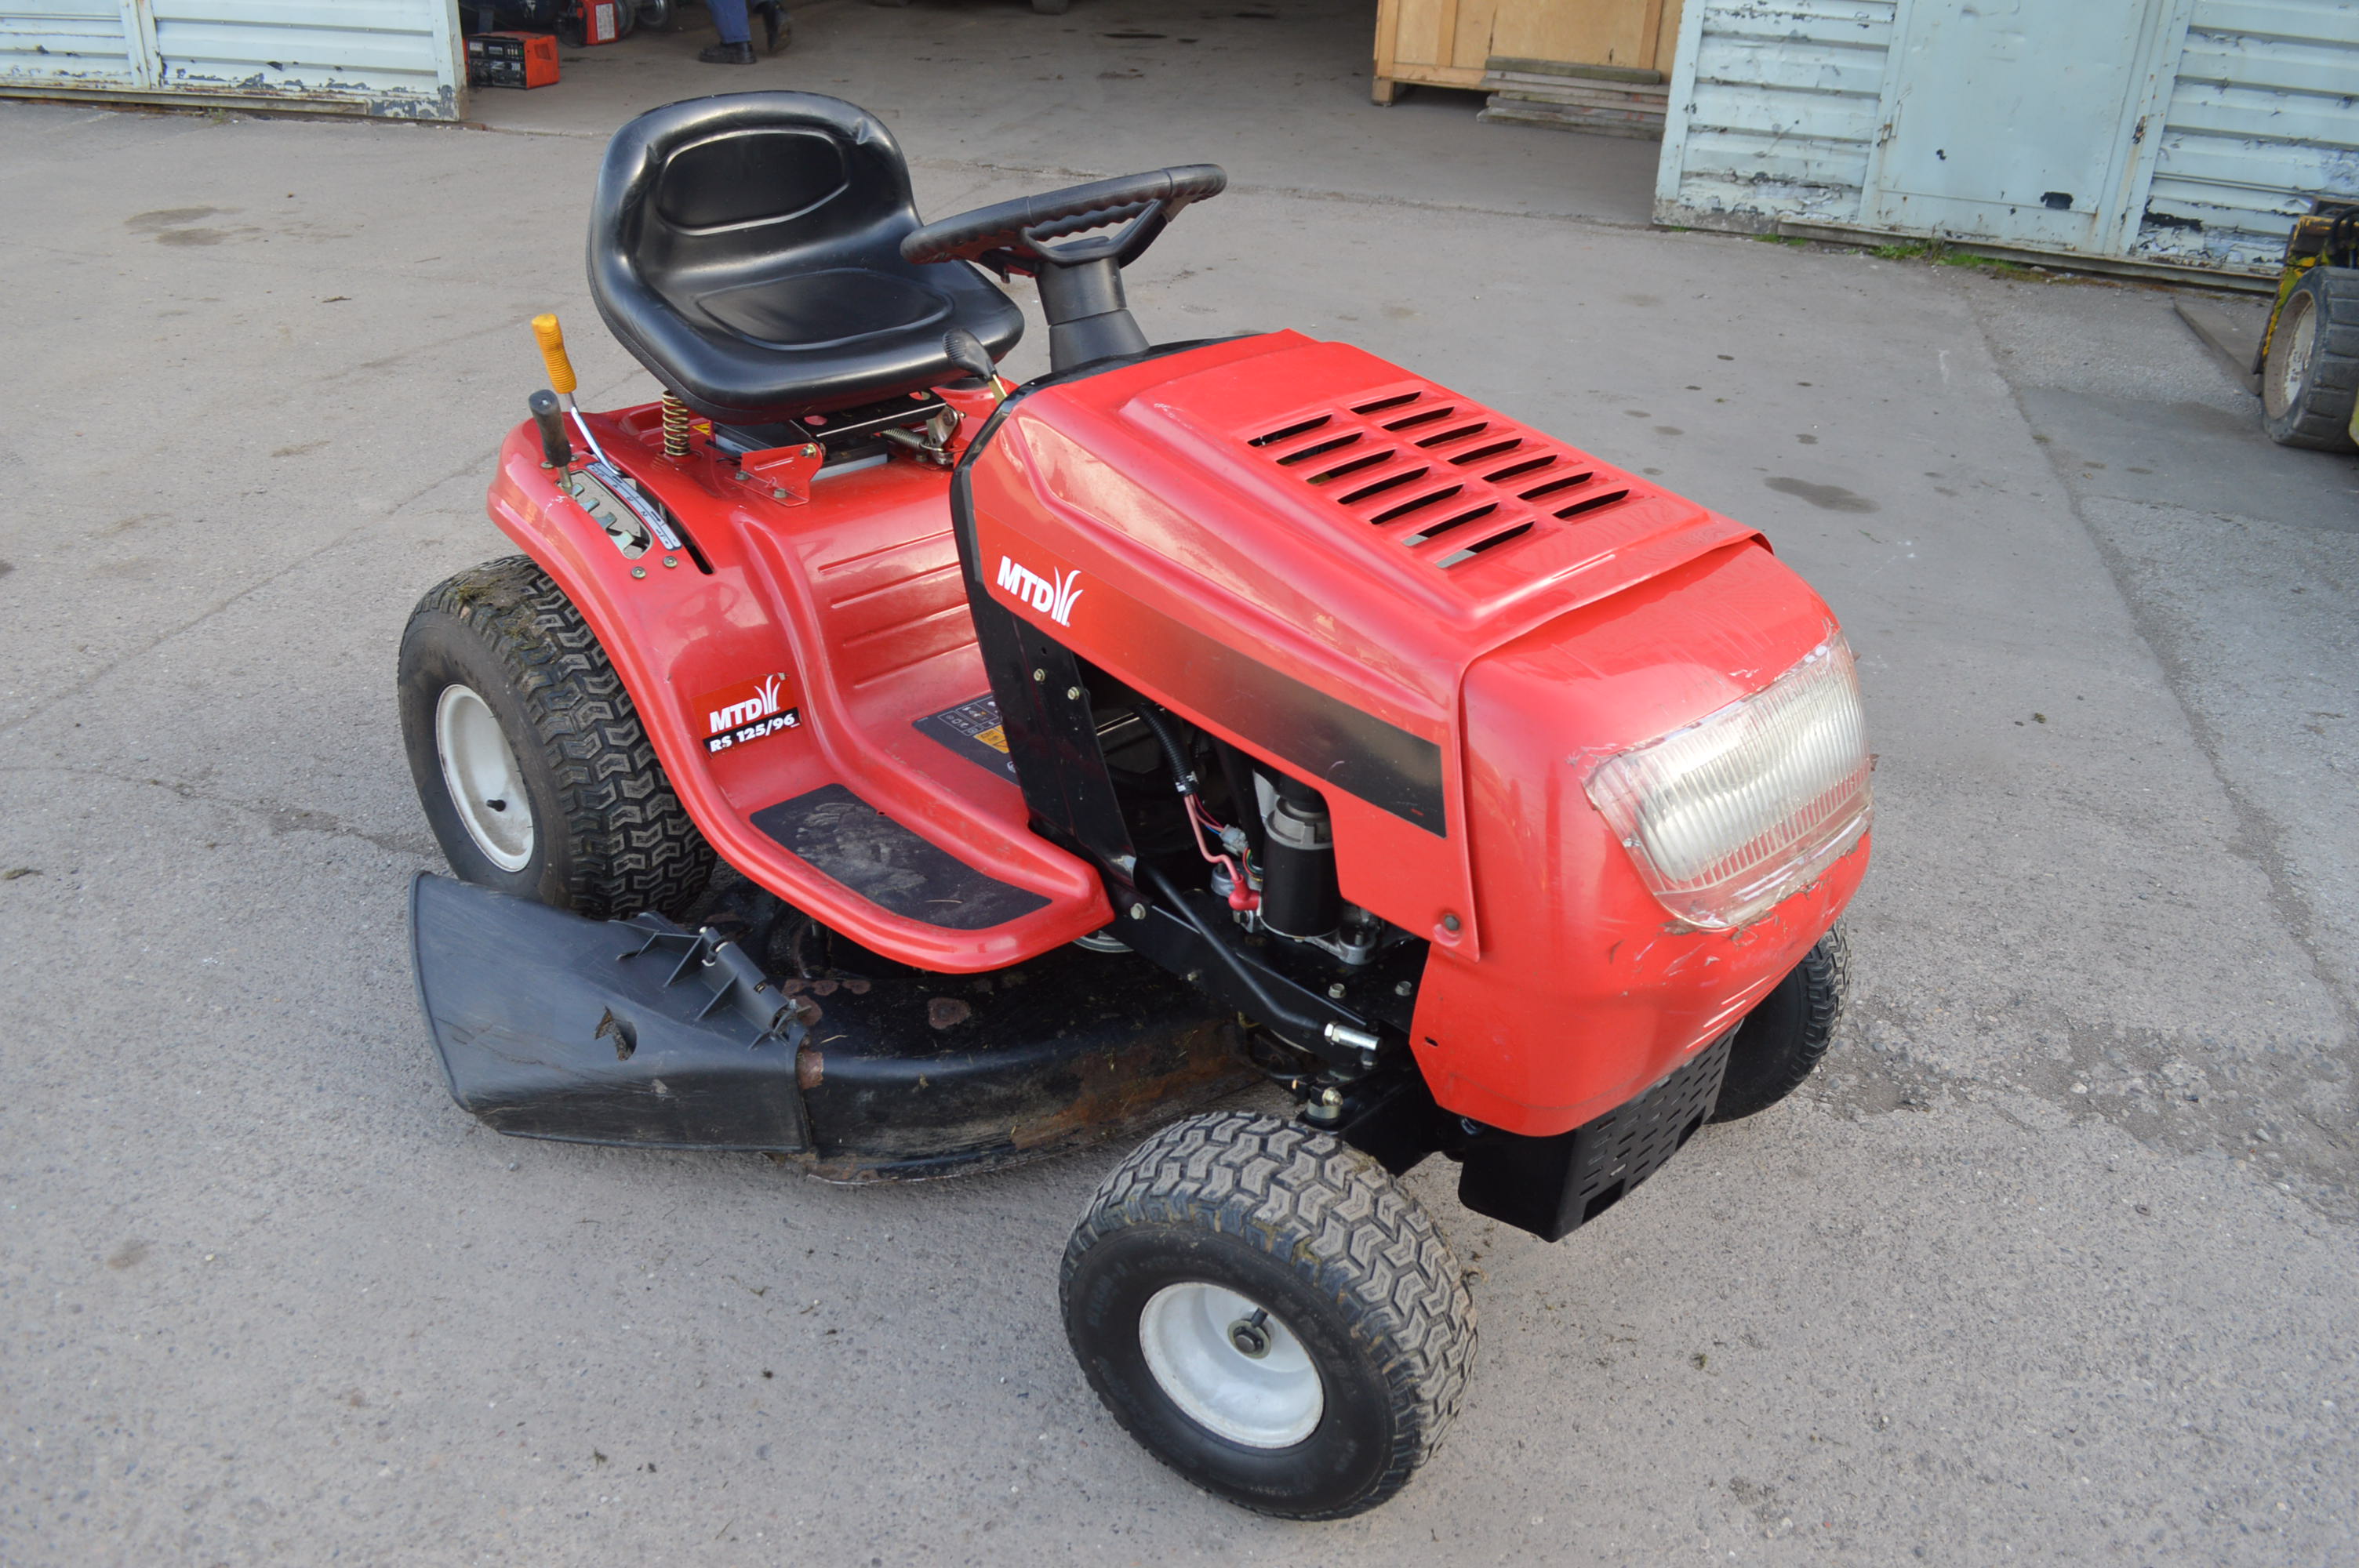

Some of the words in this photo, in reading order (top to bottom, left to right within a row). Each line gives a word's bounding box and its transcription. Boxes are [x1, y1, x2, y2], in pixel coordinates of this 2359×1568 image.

[996, 555, 1055, 613] MTD
[709, 698, 763, 734] MTD
[710, 735, 733, 753] RS
[736, 713, 795, 742] 125/96
